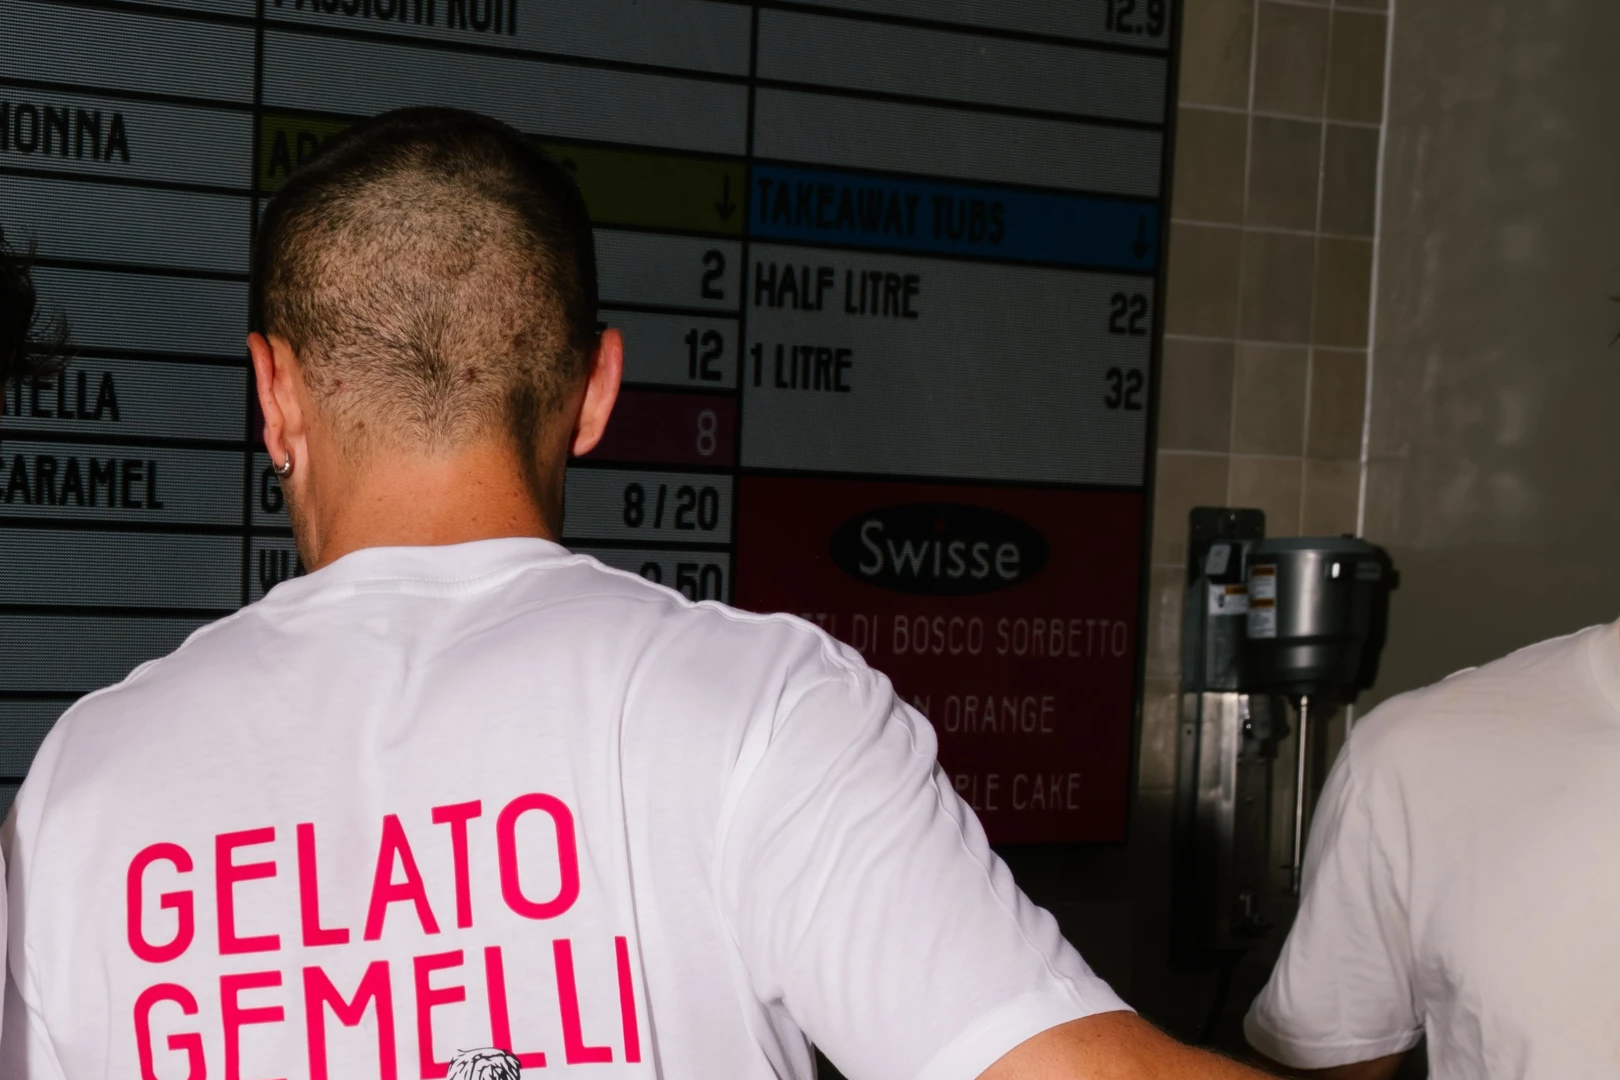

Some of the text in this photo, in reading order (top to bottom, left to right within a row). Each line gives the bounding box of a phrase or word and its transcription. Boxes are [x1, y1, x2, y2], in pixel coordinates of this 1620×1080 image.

[757, 177, 1006, 246] TAKEAWAY TUBS
[702, 250, 725, 299] 2
[755, 261, 920, 318] HALF LITRE
[1108, 292, 1148, 336] 22
[685, 328, 723, 381] 12
[775, 344, 852, 392] LITRE
[1105, 367, 1144, 411] 32
[696, 408, 718, 457] 8
[858, 517, 1021, 580] Swisse
[852, 613, 878, 654] DI
[892, 614, 984, 656] BOSCO
[996, 617, 1128, 659] SORBETTO
[944, 695, 1056, 734] ORANGE
[1012, 772, 1082, 811] CAKE
[127, 792, 581, 964] GELATO
